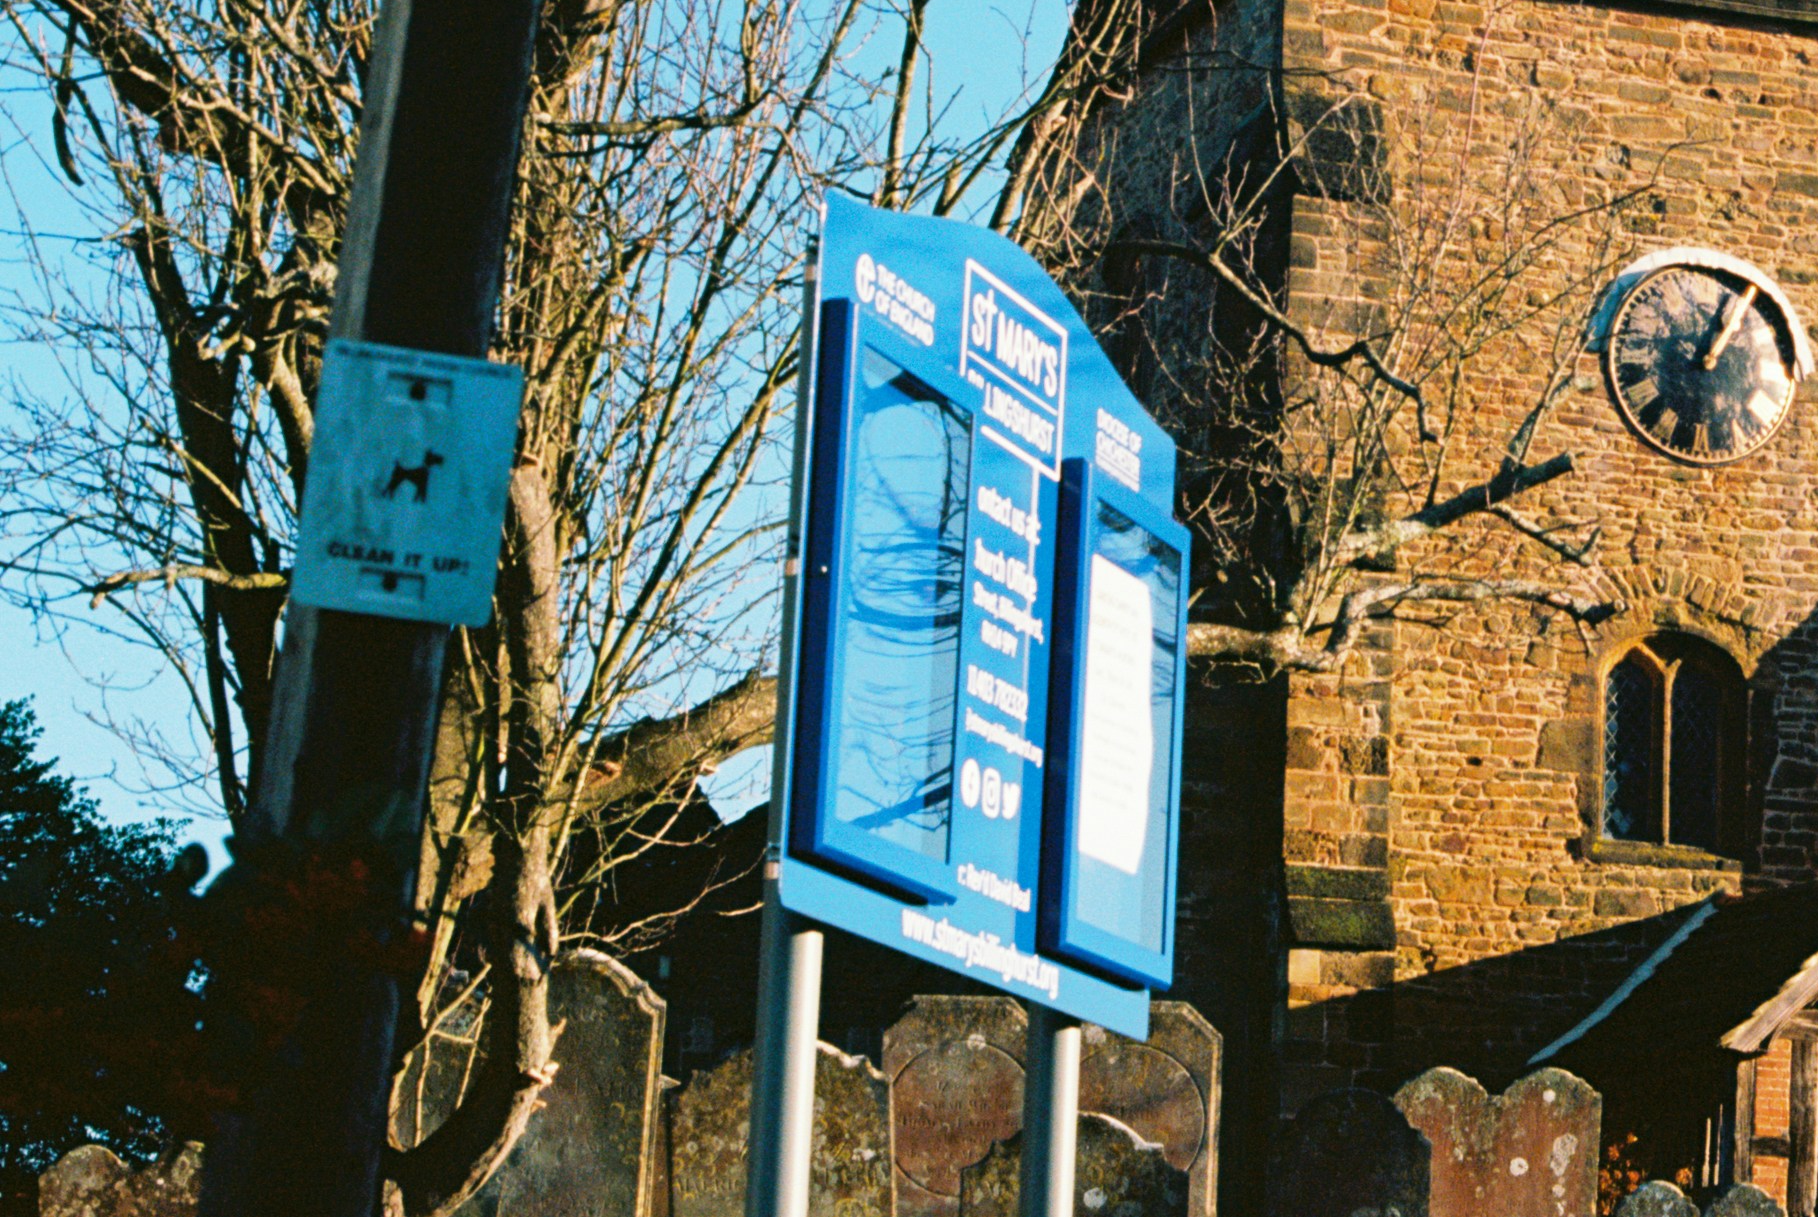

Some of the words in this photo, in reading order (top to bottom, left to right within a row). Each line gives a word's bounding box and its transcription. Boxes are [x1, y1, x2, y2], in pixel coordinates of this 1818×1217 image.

[874, 290, 891, 316] OF
[877, 264, 896, 296] THE
[896, 279, 935, 323] CHURCH
[996, 311, 1058, 397] MARY'S
[327, 541, 394, 564] CLEAN
[404, 553, 423, 568] IT
